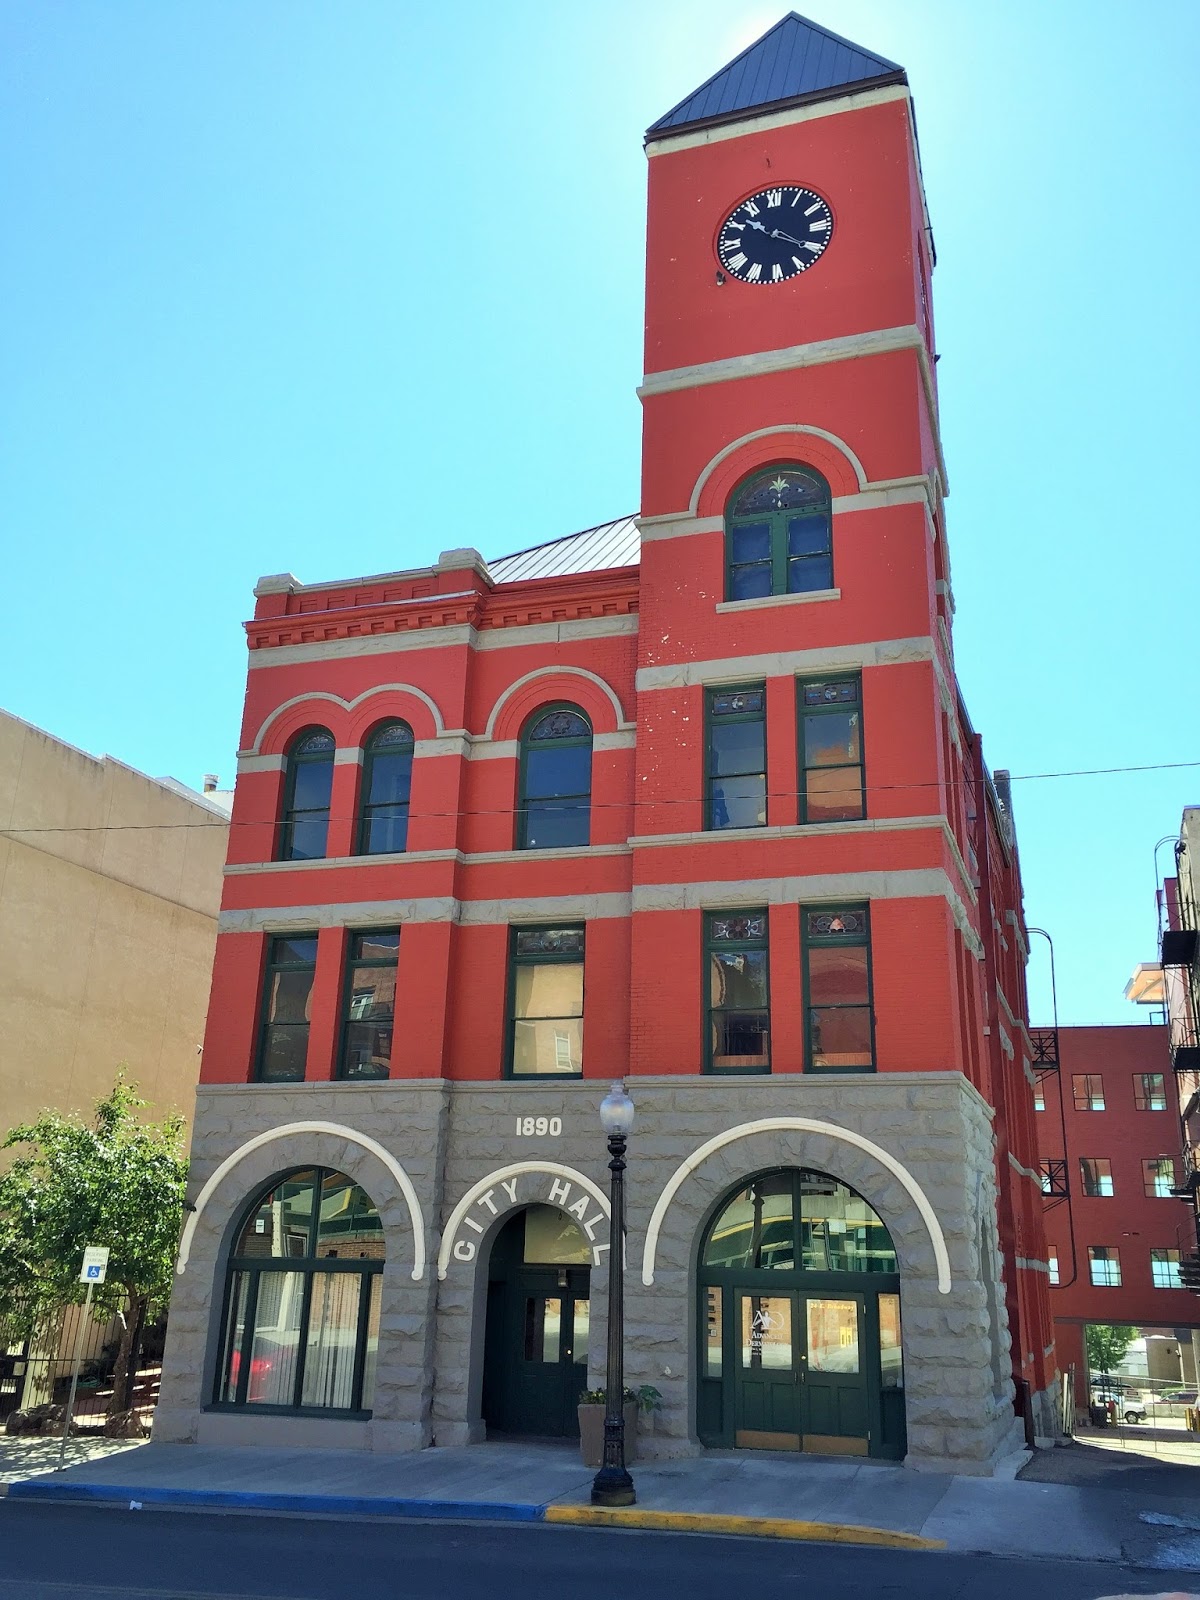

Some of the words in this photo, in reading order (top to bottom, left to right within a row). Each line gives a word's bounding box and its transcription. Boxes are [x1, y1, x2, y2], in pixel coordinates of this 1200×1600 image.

[516, 1117, 562, 1136] 1890
[453, 1177, 518, 1262] CITY
[548, 1177, 611, 1266] HALL
